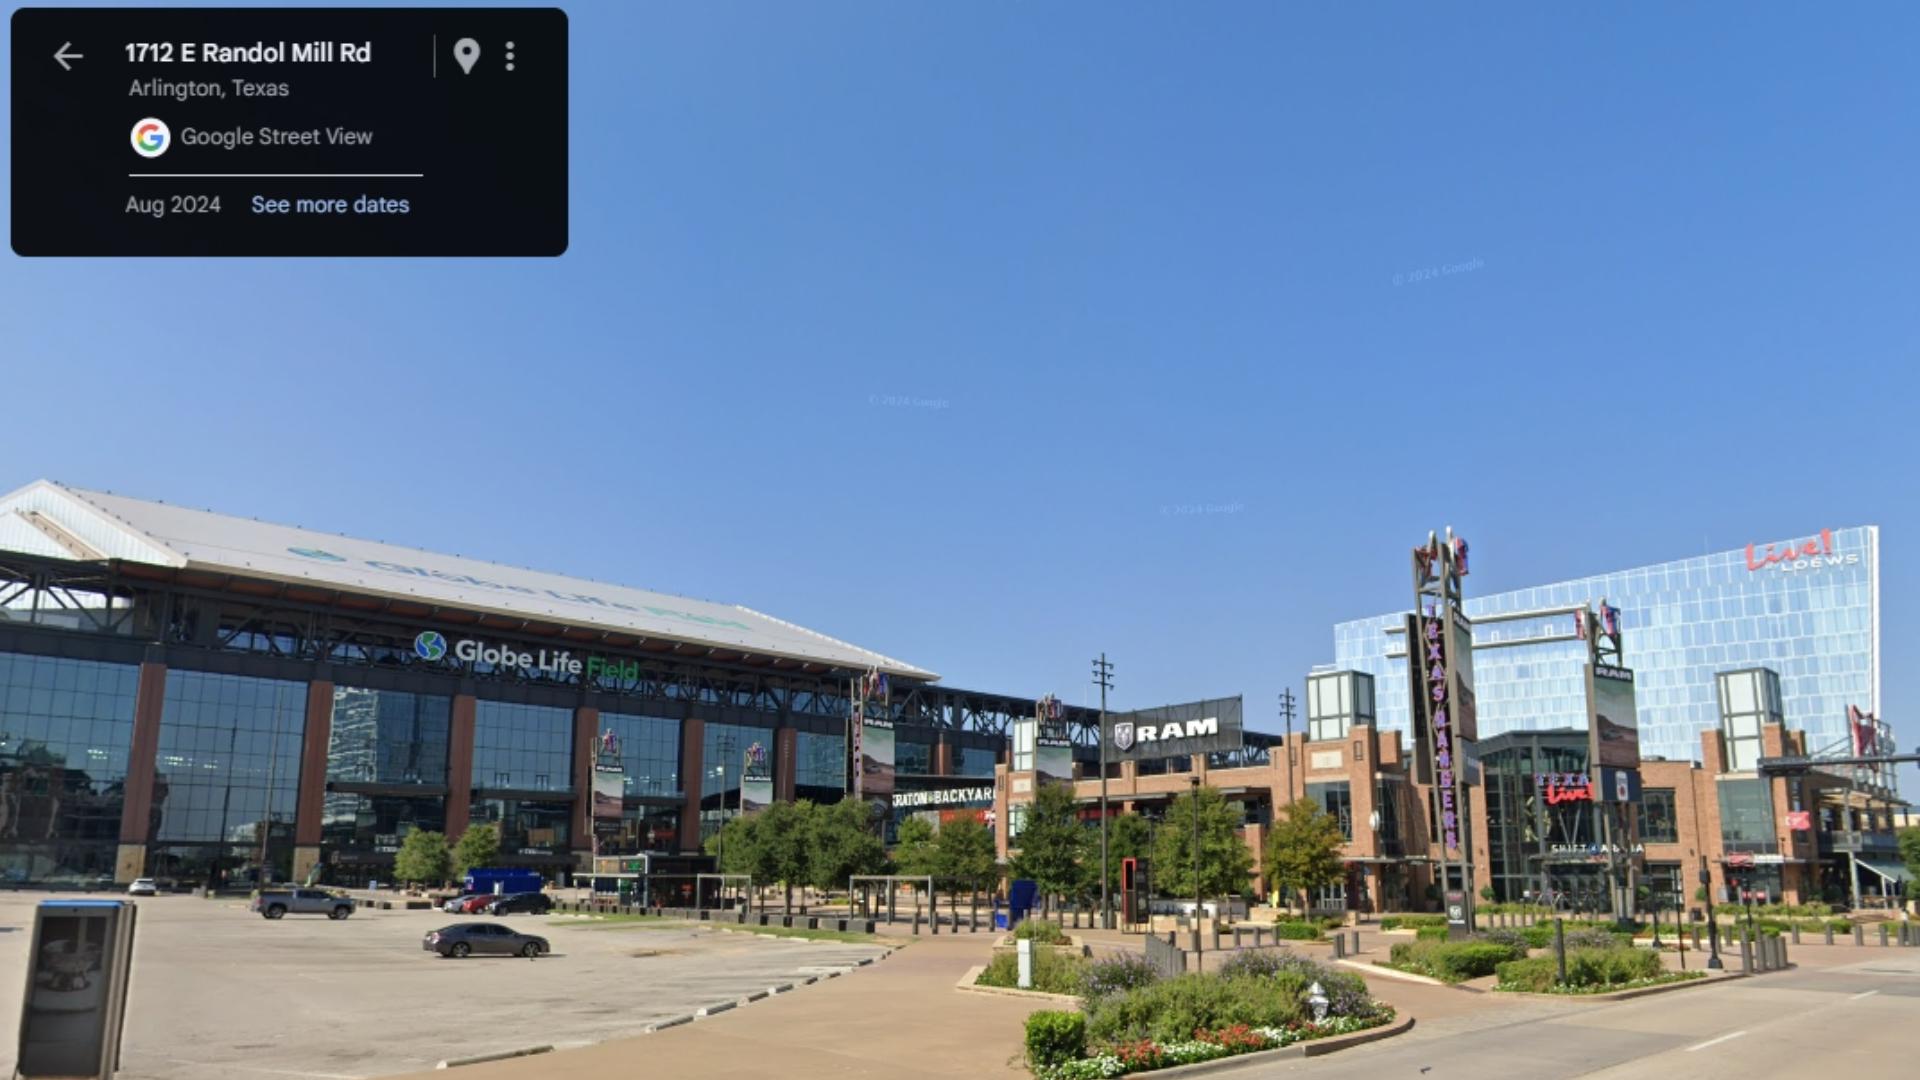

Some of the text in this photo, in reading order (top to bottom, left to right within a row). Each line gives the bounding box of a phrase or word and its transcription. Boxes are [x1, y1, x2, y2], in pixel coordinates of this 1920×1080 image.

[1744, 528, 1833, 571] Live!
[1781, 553, 1860, 573] LOEWS
[455, 639, 639, 680] Globe Life Field
[1136, 717, 1218, 743] RAM
[1426, 604, 1458, 849] TEXAS RANGERS
[1536, 773, 1590, 786] TEXA
[1546, 783, 1595, 804] Live!
